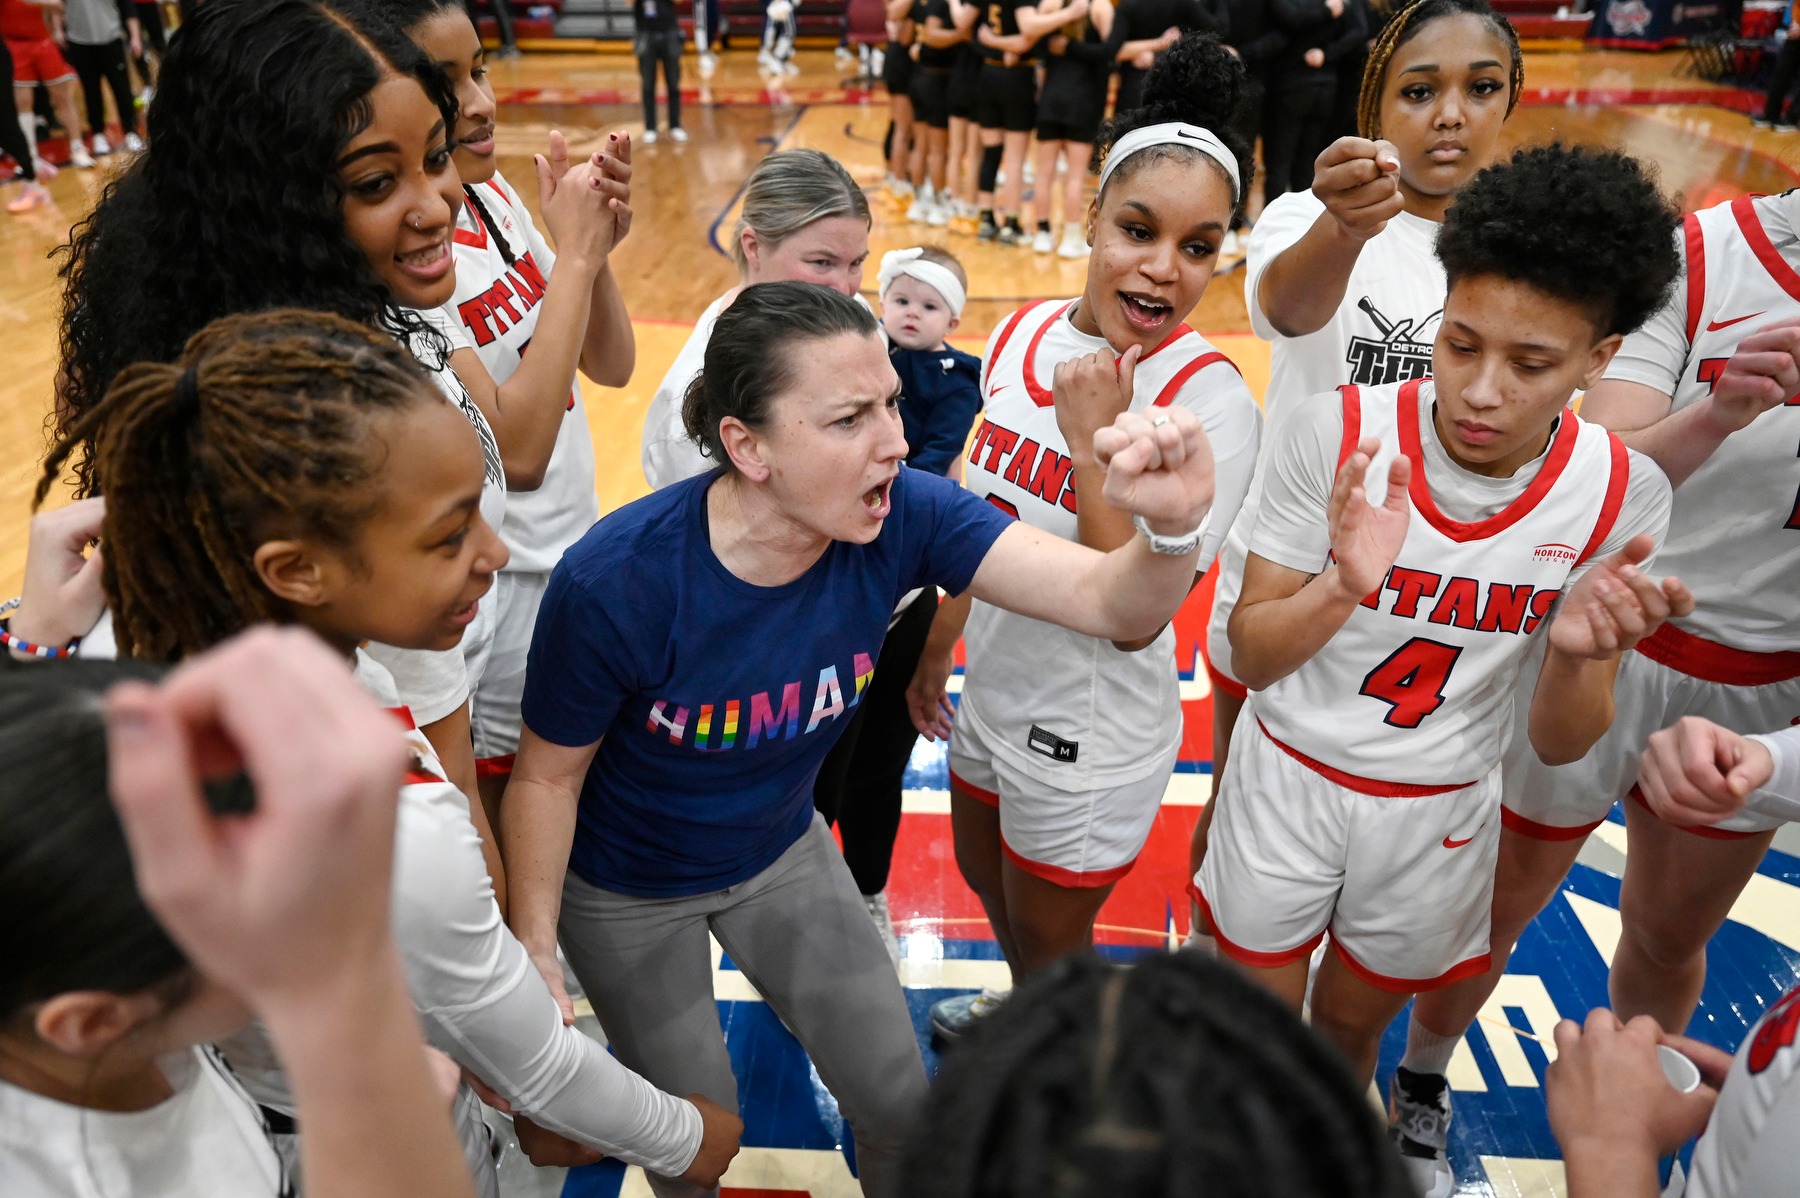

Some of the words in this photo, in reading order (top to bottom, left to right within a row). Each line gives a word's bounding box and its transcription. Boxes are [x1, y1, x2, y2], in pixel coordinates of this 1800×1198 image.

[967, 418, 1077, 514] ITAN
[1534, 549, 1576, 560] HORIZON
[1358, 636, 1464, 729] 4
[1060, 746, 1070, 757] M
